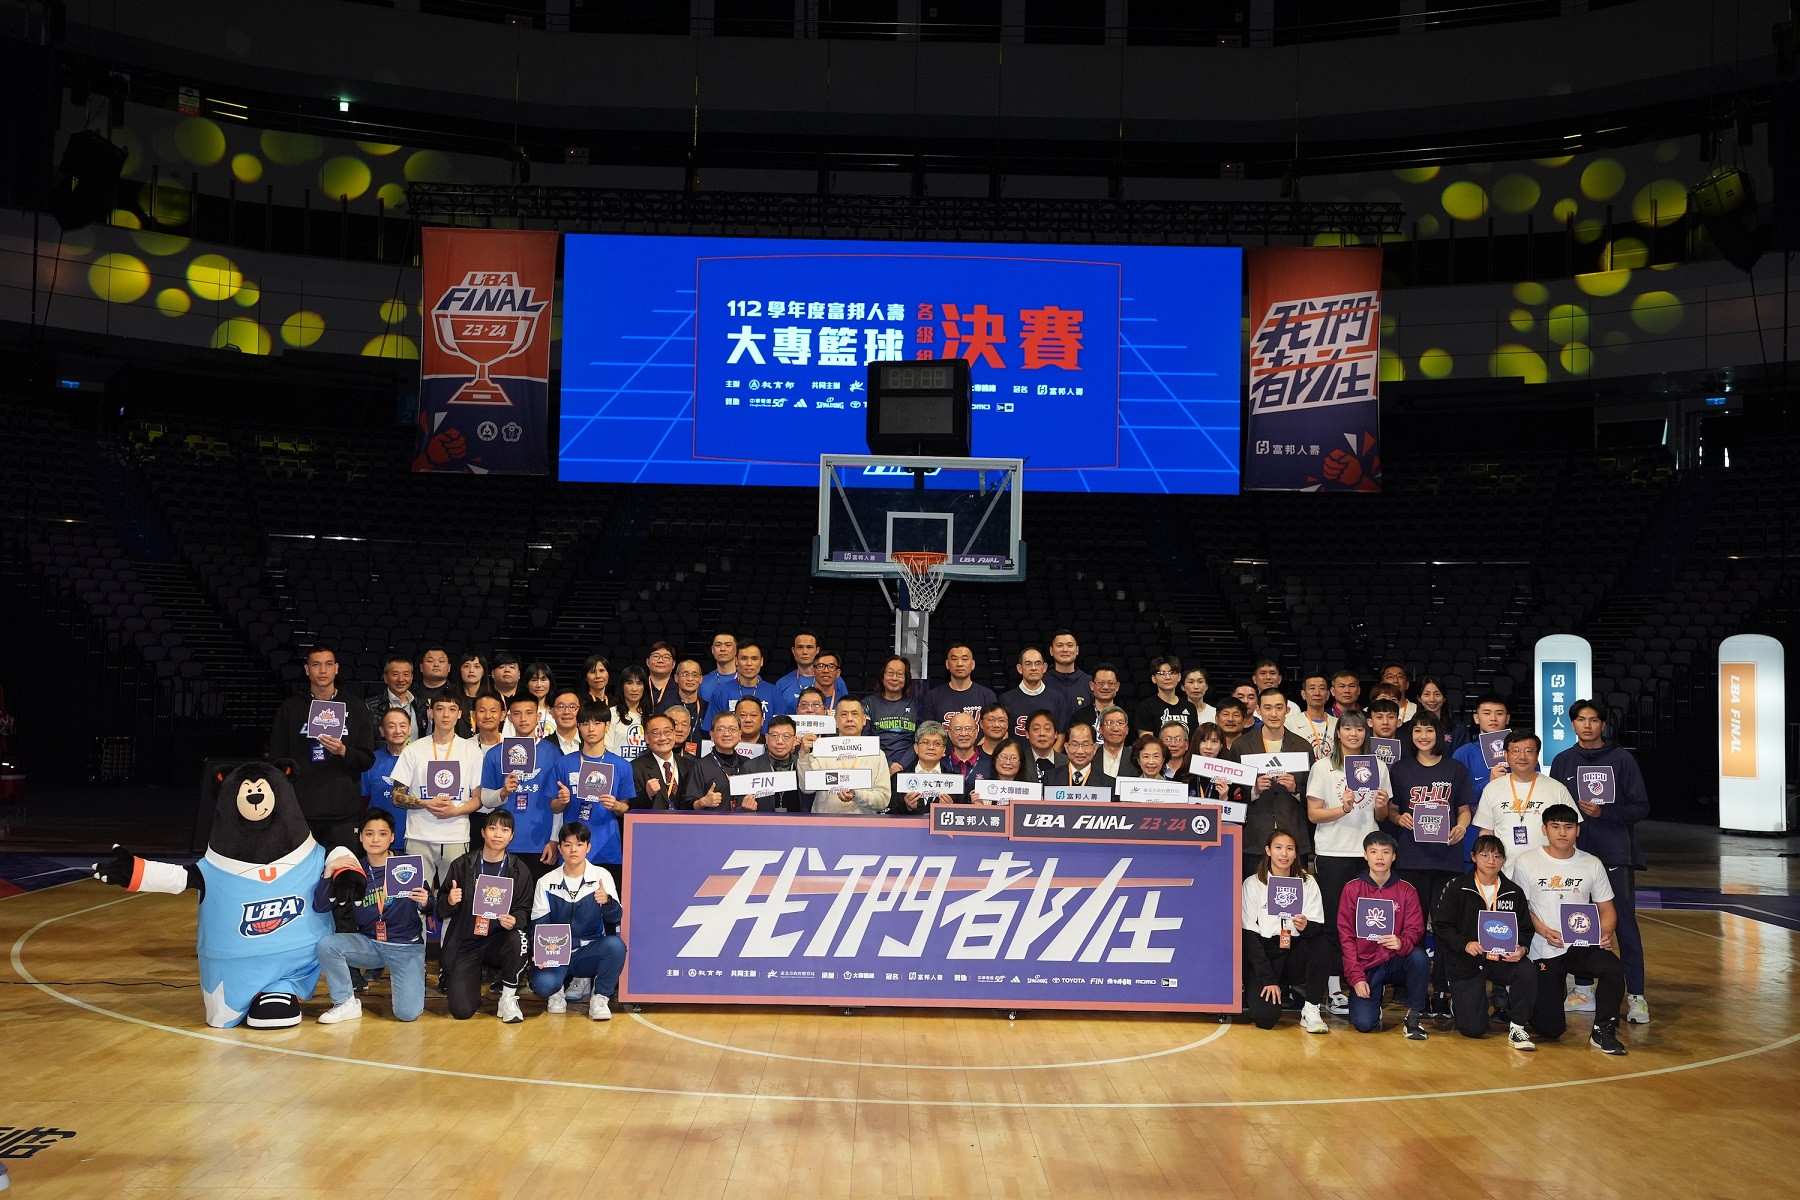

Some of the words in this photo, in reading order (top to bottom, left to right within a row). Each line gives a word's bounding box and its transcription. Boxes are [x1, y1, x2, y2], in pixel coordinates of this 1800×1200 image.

[467, 273, 514, 287] UBA
[436, 287, 546, 312] FINAL
[727, 300, 762, 317] 112
[767, 300, 905, 321] 學年度富邦人壽
[1257, 295, 1373, 355] 我們
[941, 303, 1084, 370] 決賽
[726, 325, 904, 367] 大專籃球
[1251, 348, 1371, 407] 都在
[761, 380, 795, 390] 教育部
[1049, 387, 1084, 396] 富邦人壽
[1272, 444, 1320, 456] 富邦人壽
[1730, 674, 1742, 704] UBA
[1552, 691, 1565, 742] 富邦人壽
[1730, 708, 1742, 754] FINAL
[831, 743, 863, 753] SPALDING
[1203, 761, 1244, 778] momo
[1583, 772, 1608, 781] NCCU
[751, 776, 775, 789] FIN
[922, 780, 954, 788] 教育部
[999, 786, 1030, 796] 大專體總
[1066, 792, 1099, 800] 富邦人壽
[1410, 786, 1452, 802] SHU
[954, 815, 1000, 827] 富邦人壽
[1023, 813, 1066, 828] UBA
[1072, 815, 1134, 830] FINAL
[258, 867, 278, 882] U
[244, 900, 298, 922] UBA
[672, 847, 1184, 963] 我們都在
[1497, 900, 1515, 910] NCCU
[1571, 916, 1587, 930] 虎
[697, 969, 723, 977] 教育部
[1090, 977, 1104, 985] FIN
